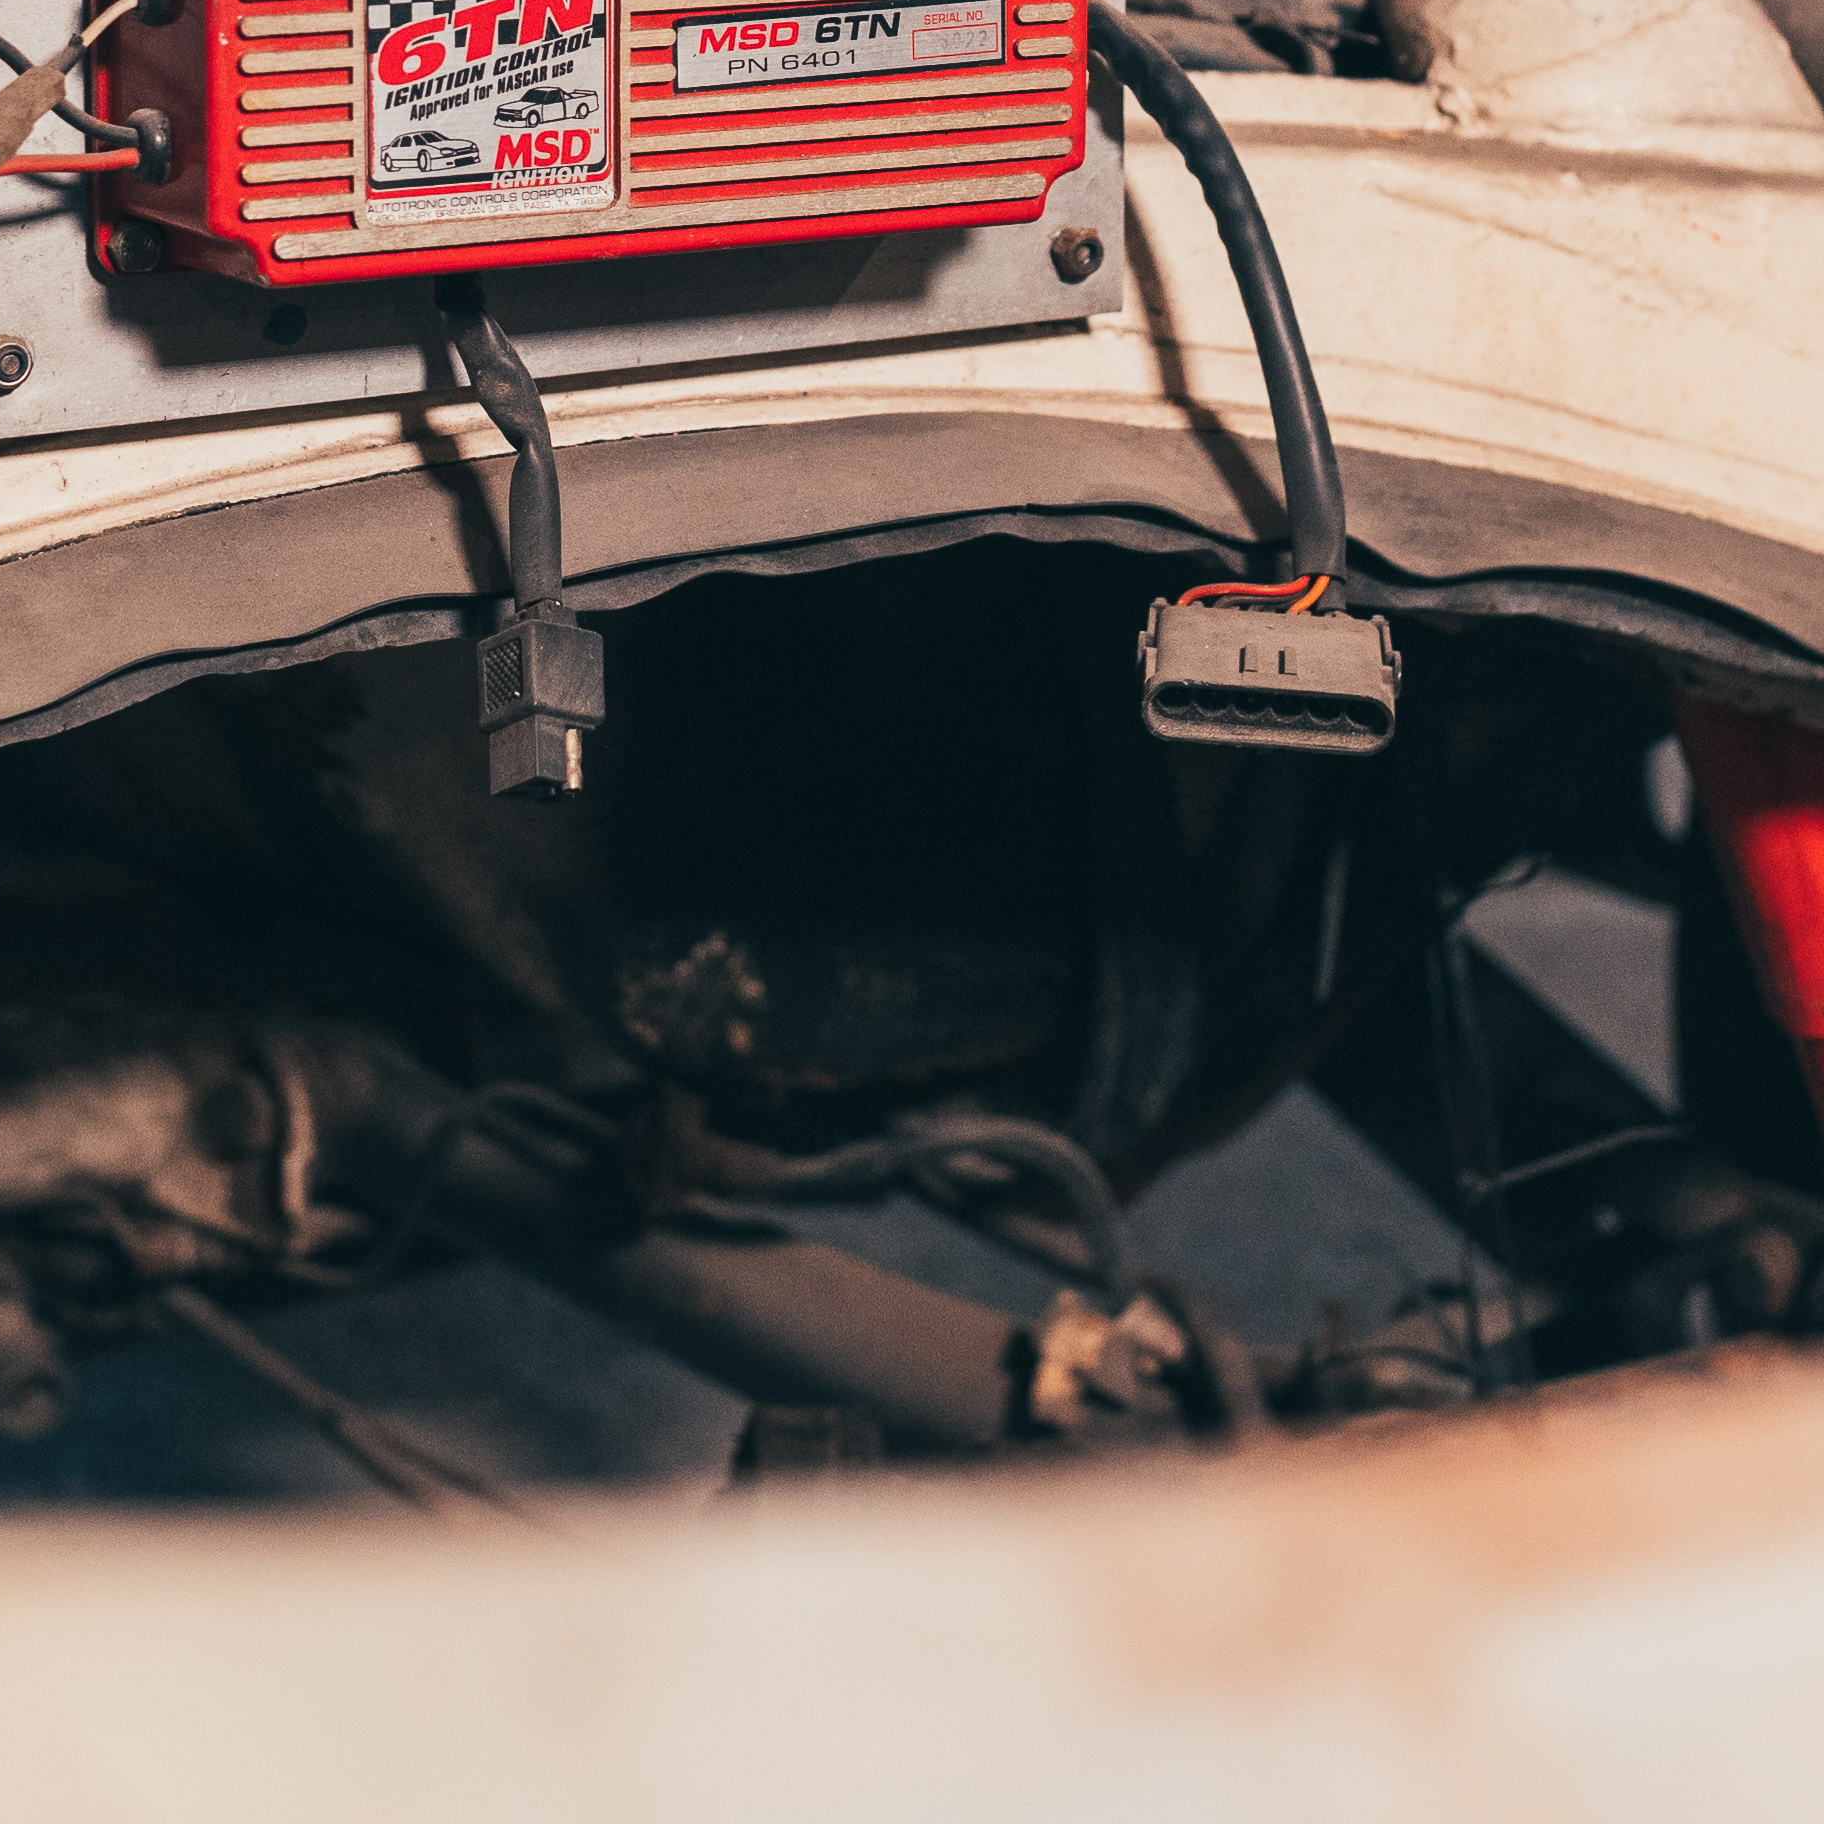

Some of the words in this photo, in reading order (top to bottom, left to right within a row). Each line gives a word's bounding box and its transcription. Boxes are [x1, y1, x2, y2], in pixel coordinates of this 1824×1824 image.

[923, 12, 963, 26] SERIAL
[966, 9, 984, 22] NO
[699, 21, 800, 55] MSD
[814, 11, 901, 43] 6TN
[384, 62, 486, 110] IGNITION
[493, 30, 593, 76] CONTROL
[728, 58, 768, 76] PN
[781, 49, 857, 71] 6401
[410, 88, 470, 121] Approved
[474, 82, 494, 102] for
[497, 65, 548, 95] NASCAR
[552, 59, 575, 78] use
[494, 128, 592, 170] MSD
[491, 165, 589, 189] IGNITION
[367, 198, 447, 214] AUTOTRONIC
[450, 191, 518, 207] CONTROLS
[521, 185, 608, 202] CORPORATION
[397, 210, 432, 221] HENRY
[435, 205, 486, 218] BRENNAN
